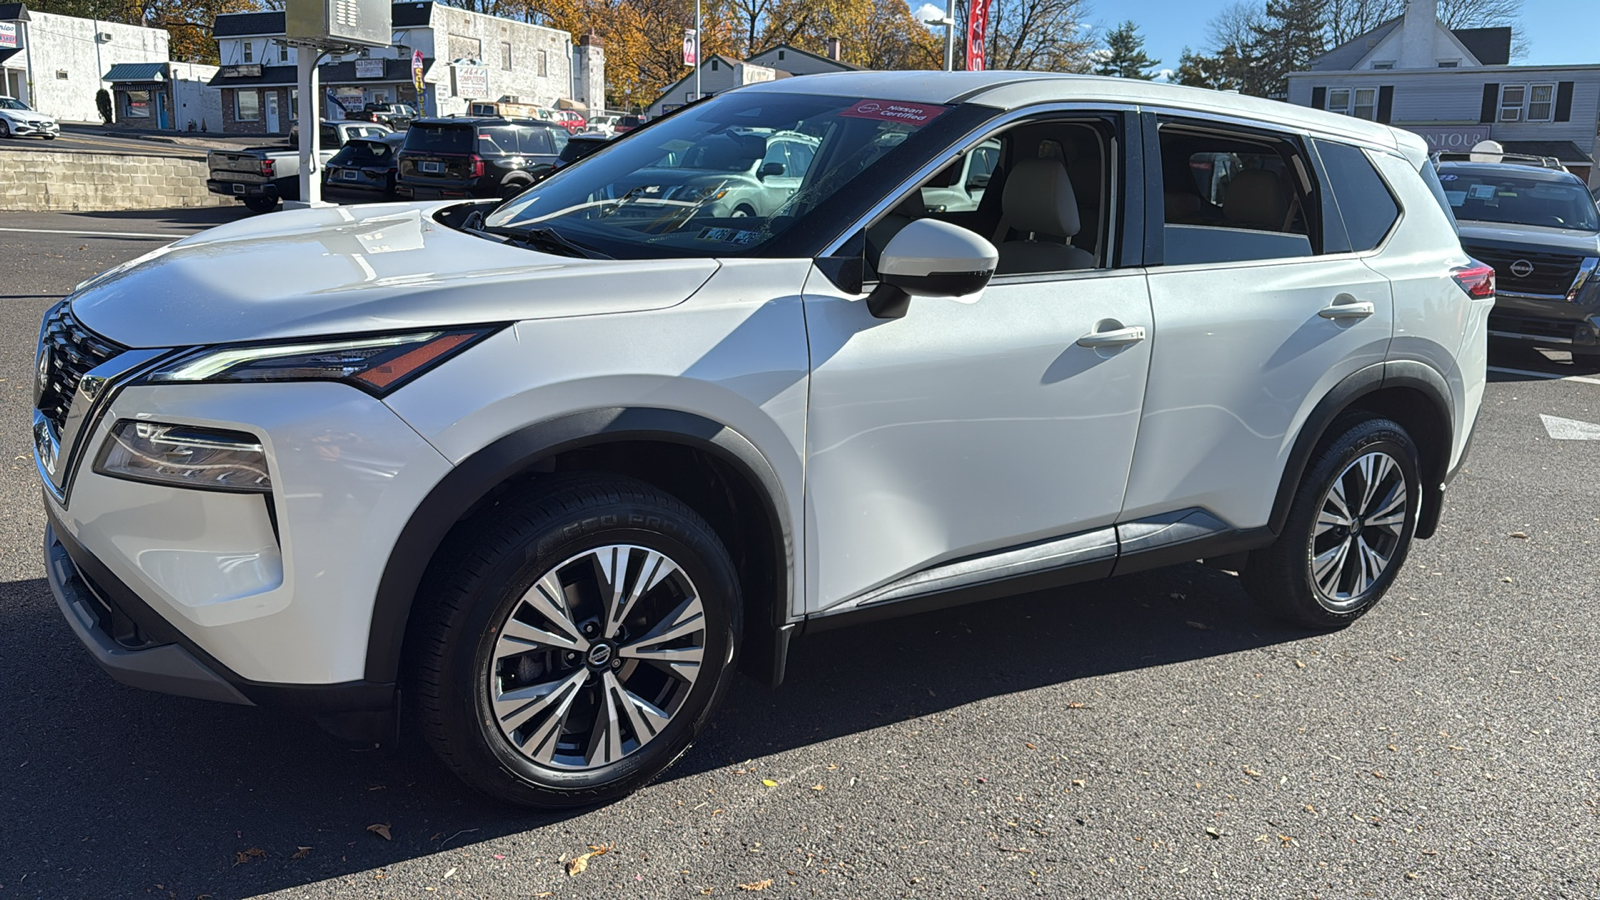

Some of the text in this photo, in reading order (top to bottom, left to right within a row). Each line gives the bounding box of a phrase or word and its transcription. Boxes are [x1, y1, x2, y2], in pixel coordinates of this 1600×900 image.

[887, 105, 924, 114] Nissan
[880, 110, 927, 121] Certified
[1422, 133, 1481, 147] NTOUR
